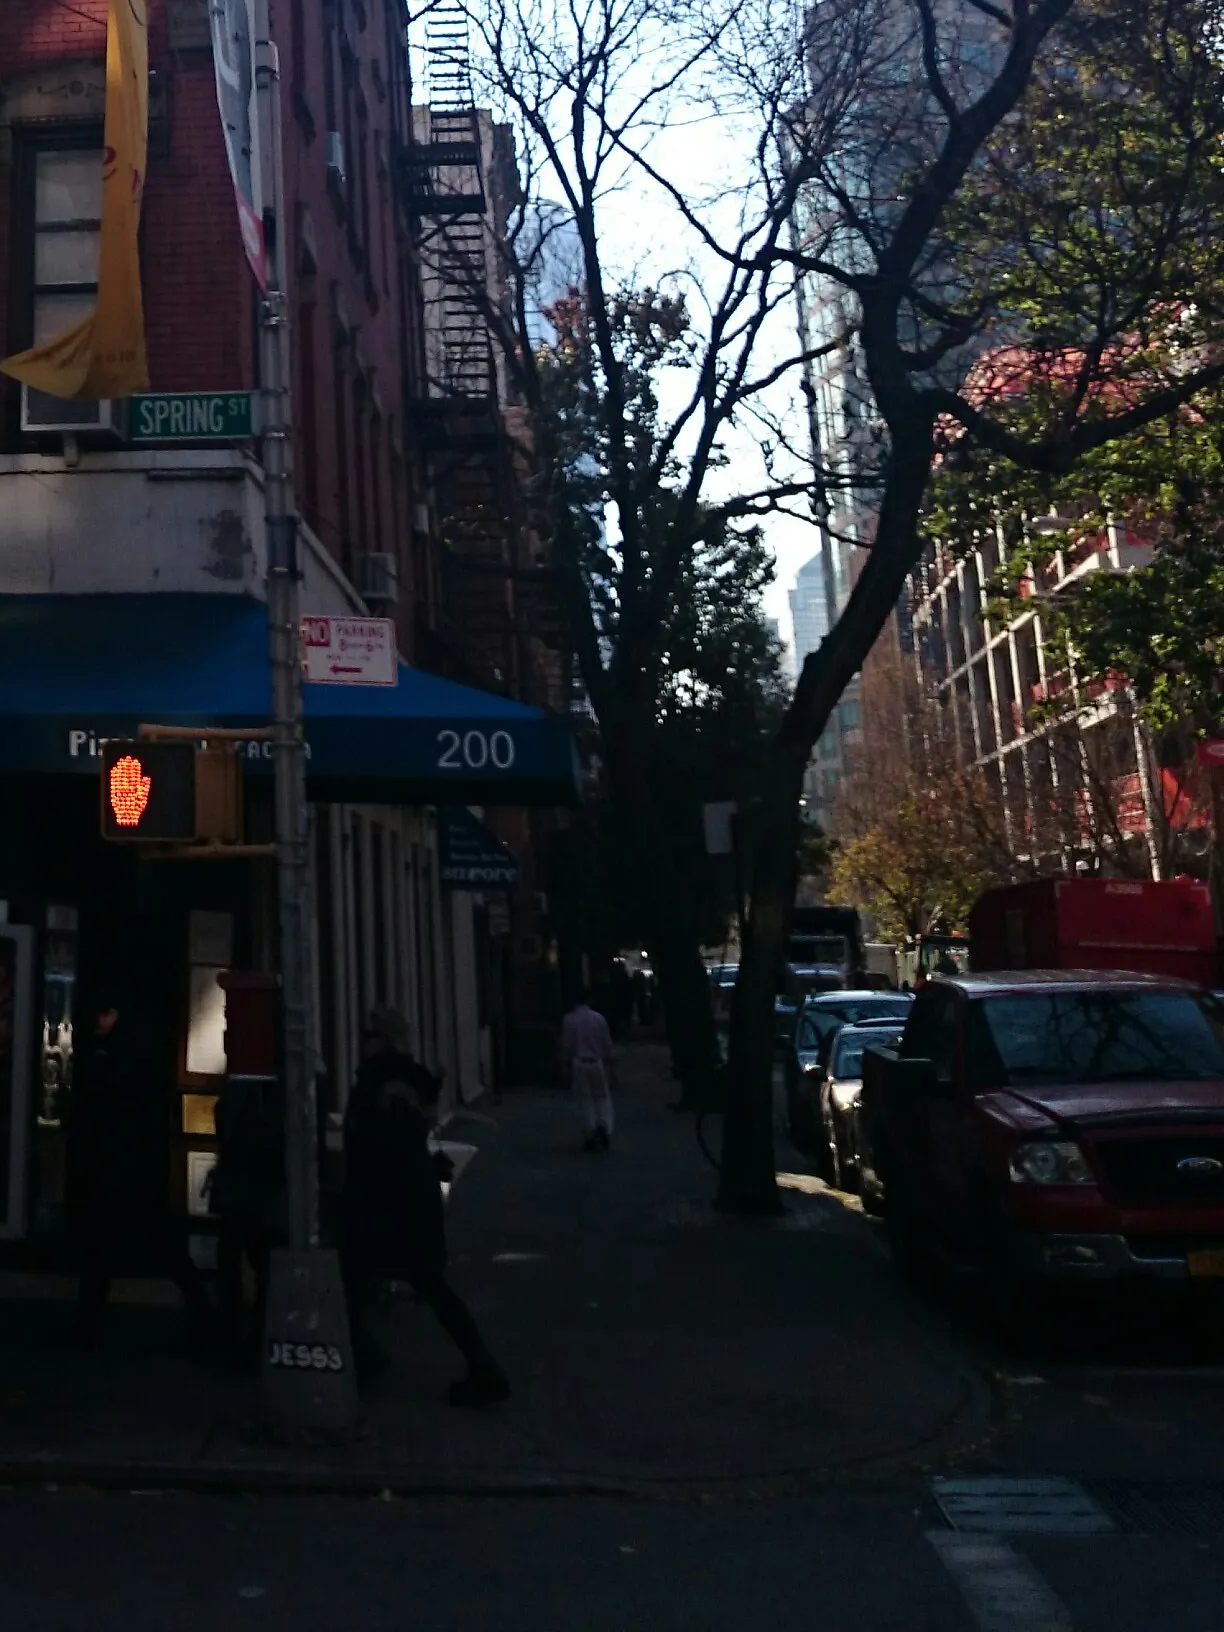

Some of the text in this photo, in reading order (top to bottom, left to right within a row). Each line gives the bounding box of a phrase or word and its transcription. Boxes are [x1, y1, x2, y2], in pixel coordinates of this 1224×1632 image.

[139, 397, 248, 435] SPRING ST
[303, 623, 328, 644] NO
[436, 729, 516, 769] 200
